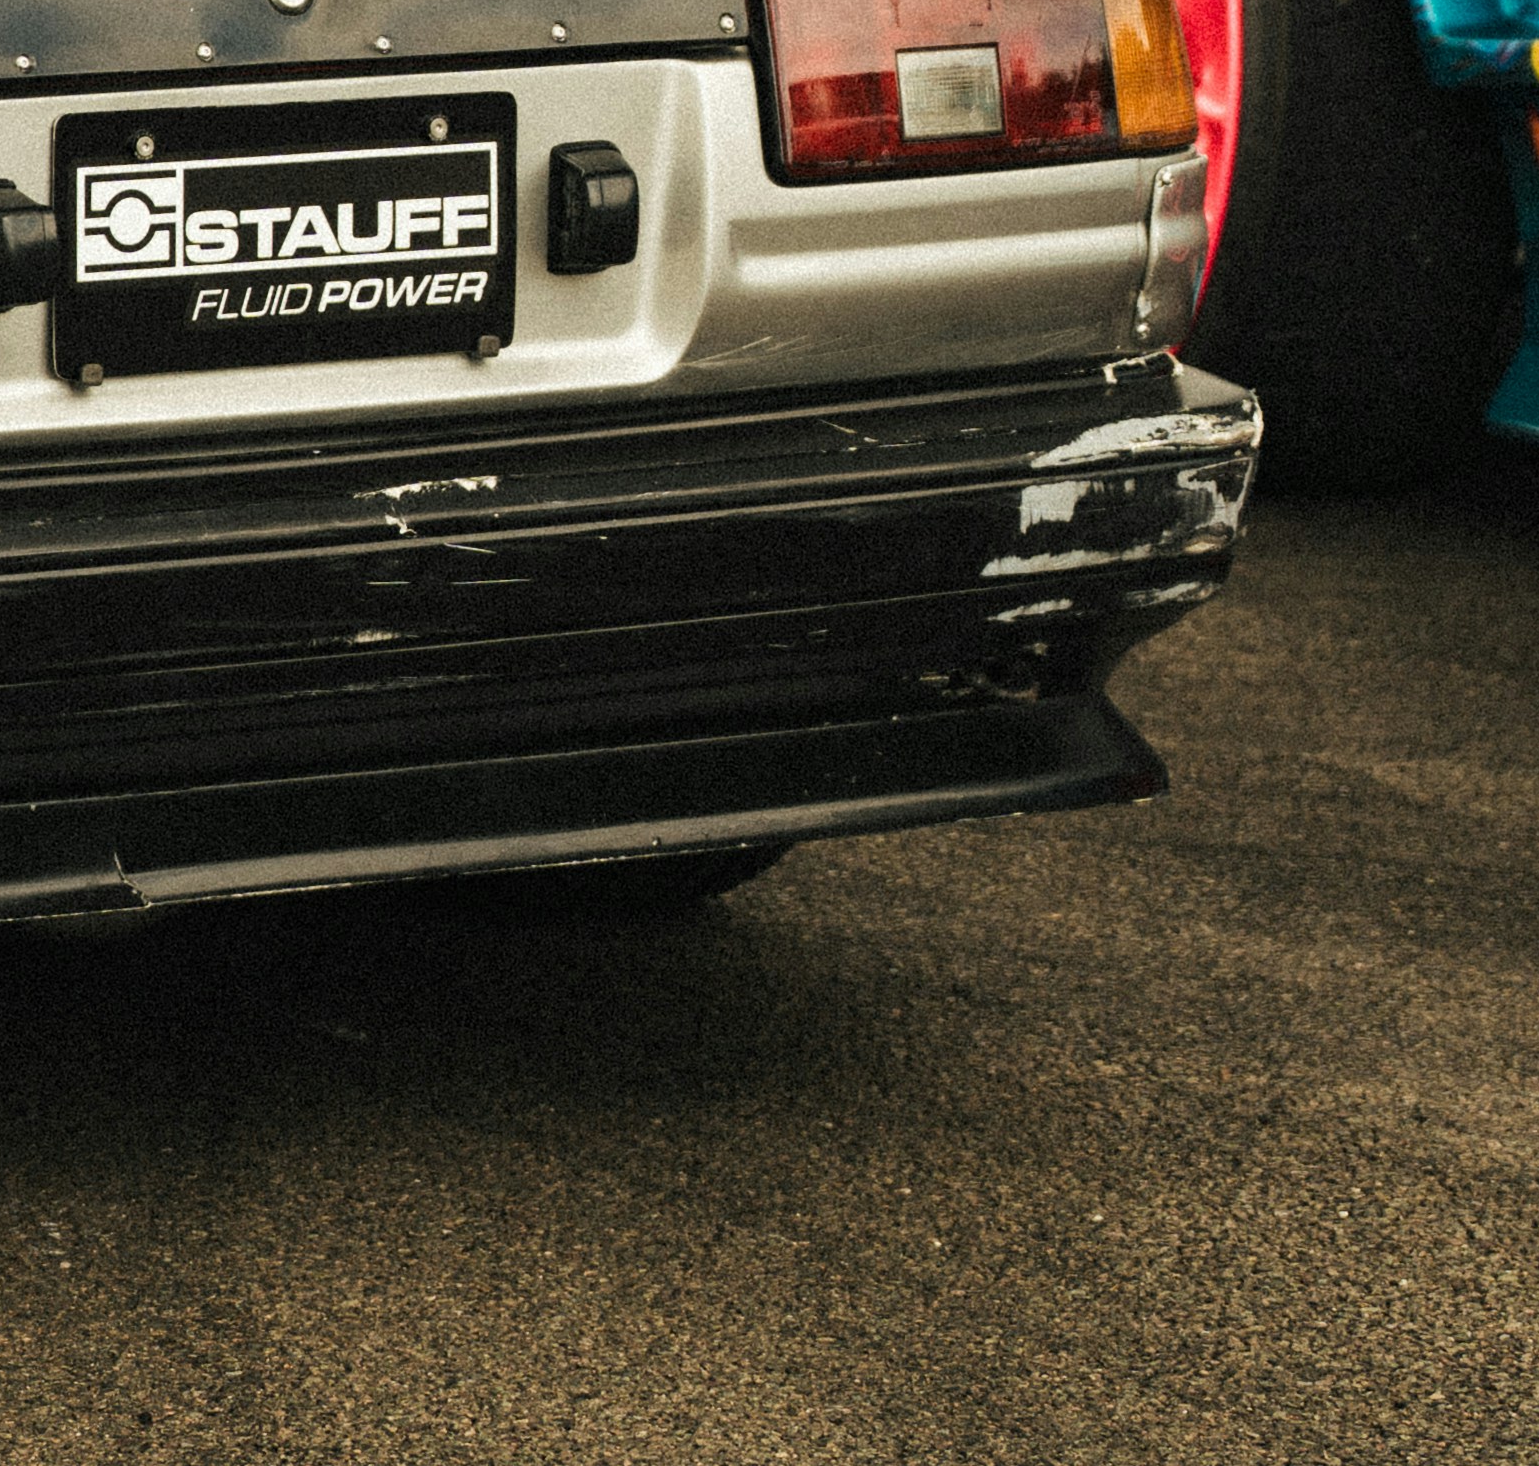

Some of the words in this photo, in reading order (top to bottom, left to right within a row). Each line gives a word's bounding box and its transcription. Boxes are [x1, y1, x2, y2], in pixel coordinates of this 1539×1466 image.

[184, 194, 490, 263] STAUFF
[191, 282, 313, 321] FLUID
[318, 271, 489, 312] POWER
